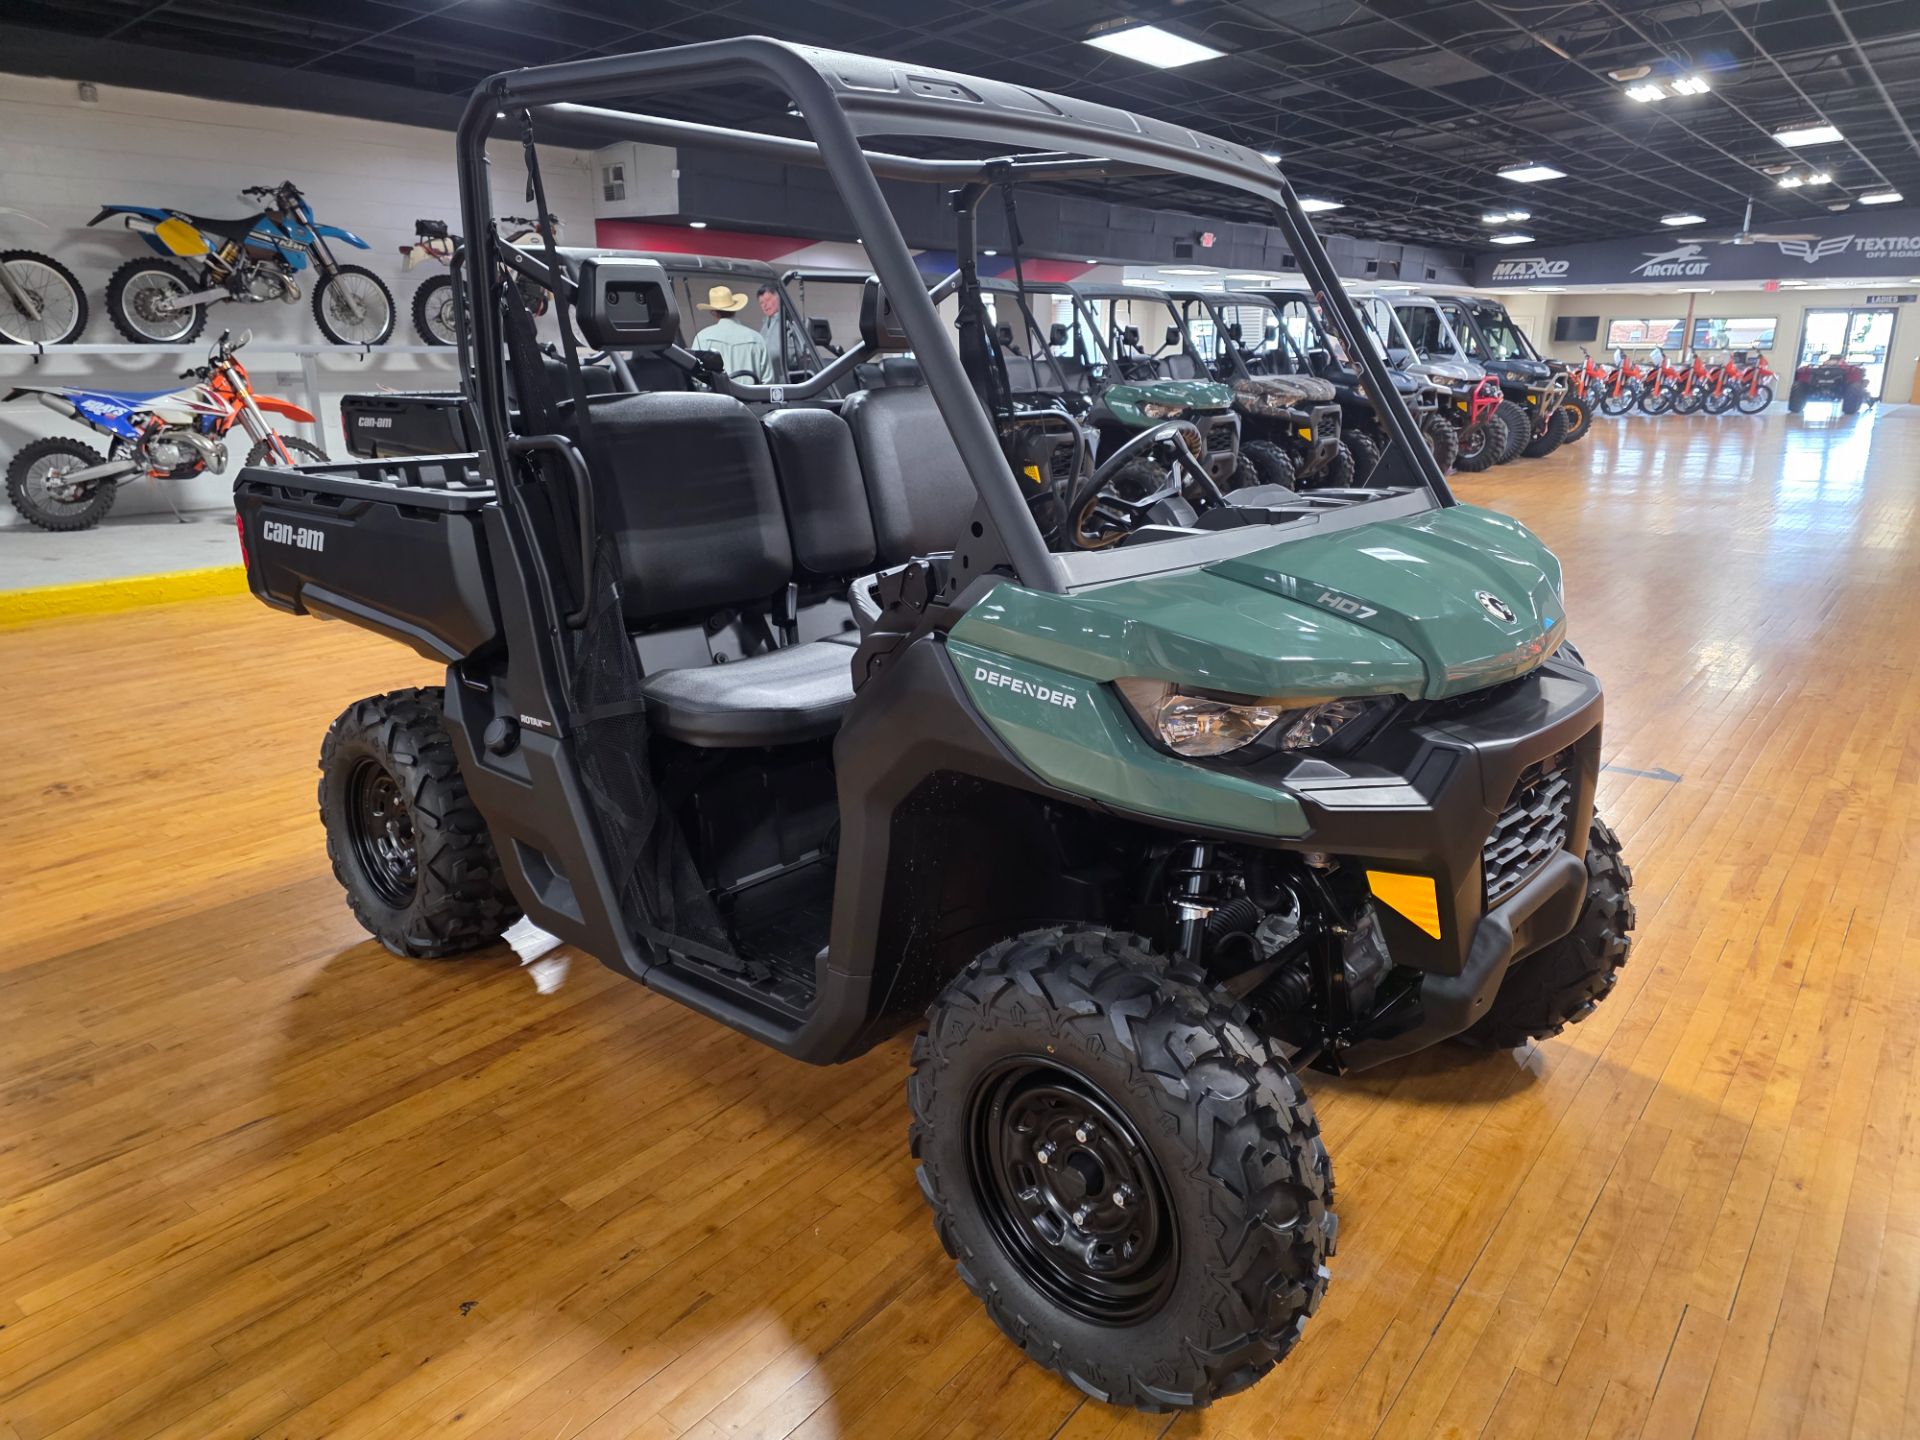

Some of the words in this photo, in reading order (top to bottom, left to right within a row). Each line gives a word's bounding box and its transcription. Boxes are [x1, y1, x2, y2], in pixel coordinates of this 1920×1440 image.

[1866, 251, 1888, 260] OFF
[1492, 258, 1570, 277] MAXXD
[1642, 263, 1683, 277] ARCTIC
[1685, 262, 1711, 276] CAT
[357, 416, 393, 428] can-am
[263, 520, 325, 552] can-am
[1316, 591, 1378, 619] HD7
[974, 667, 1077, 710] DEFENDER
